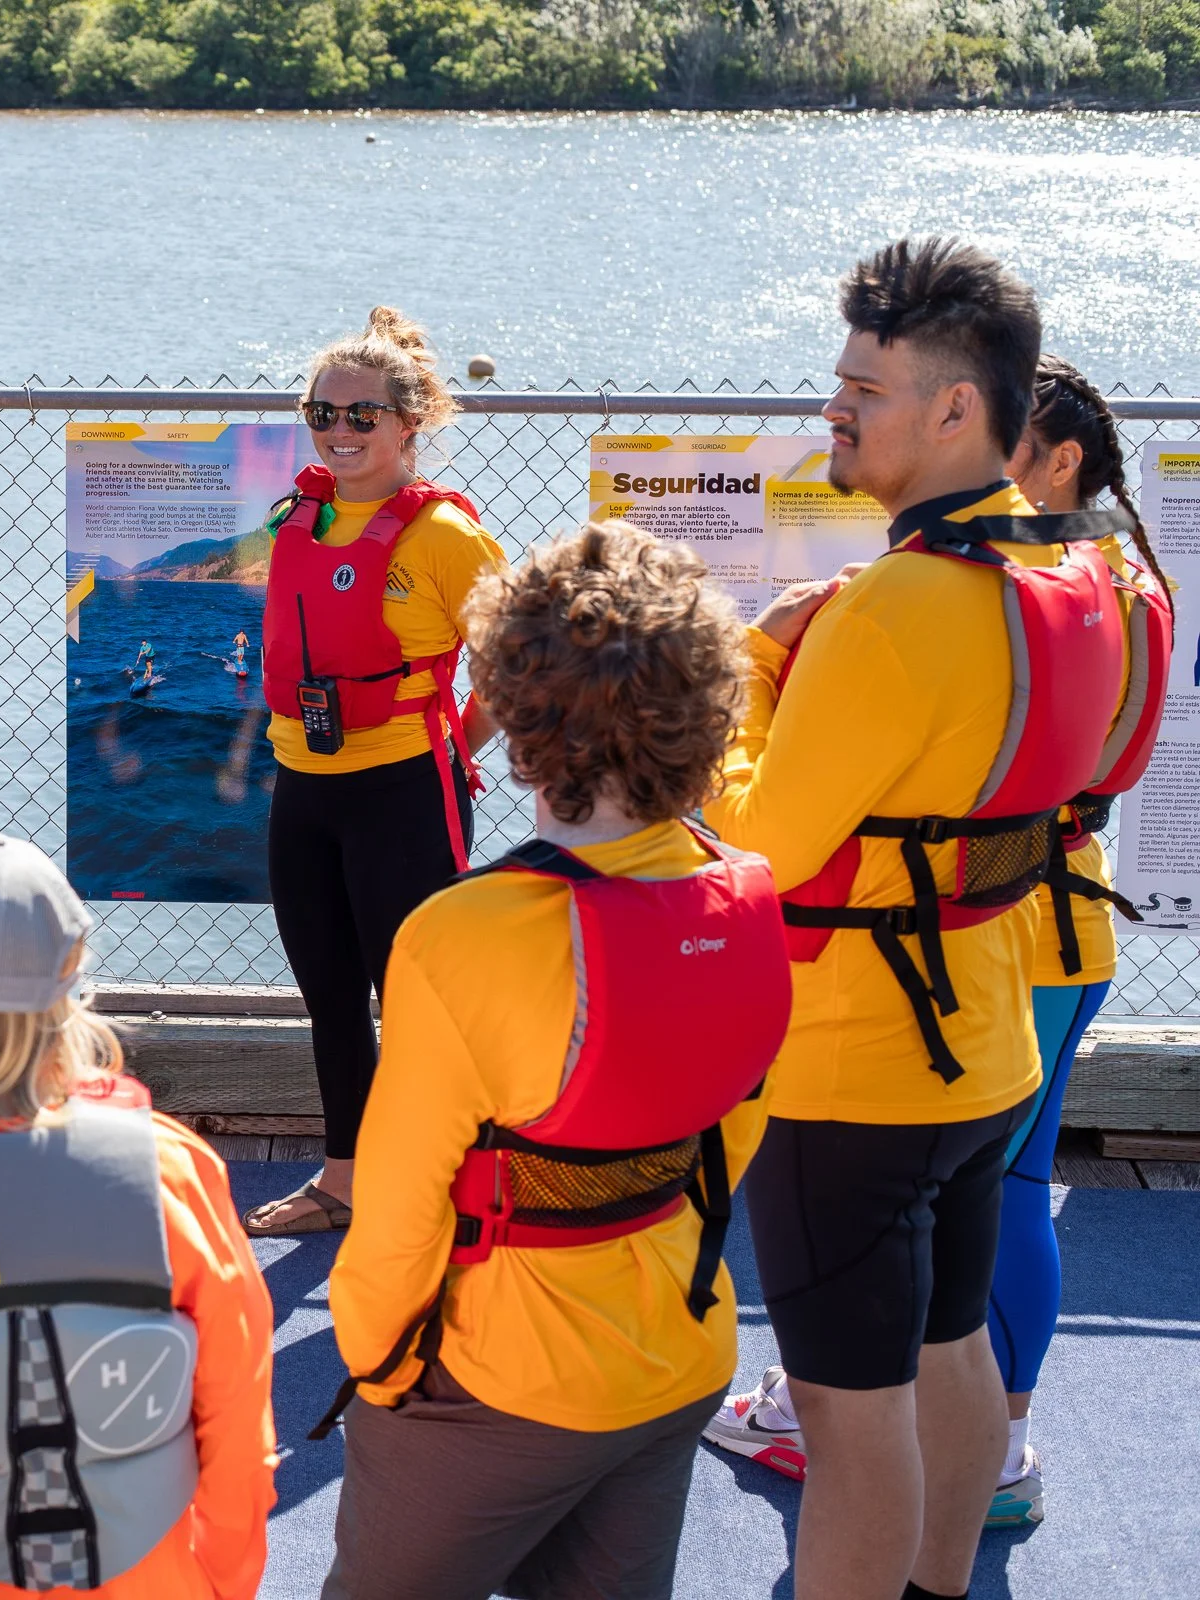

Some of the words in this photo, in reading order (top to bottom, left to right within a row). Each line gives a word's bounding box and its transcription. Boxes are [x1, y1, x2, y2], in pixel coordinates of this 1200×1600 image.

[86, 462, 108, 470] Going
[101, 476, 123, 484] safety
[189, 477, 224, 485] Watching
[612, 473, 760, 497] Seguridad
[165, 483, 201, 492] guarantee
[158, 505, 177, 513] Wylde
[180, 505, 205, 513] showing
[729, 527, 763, 535] pesadilla
[400, 566, 415, 589] WATER
[101, 1359, 127, 1389] H
[145, 1394, 163, 1420] L
